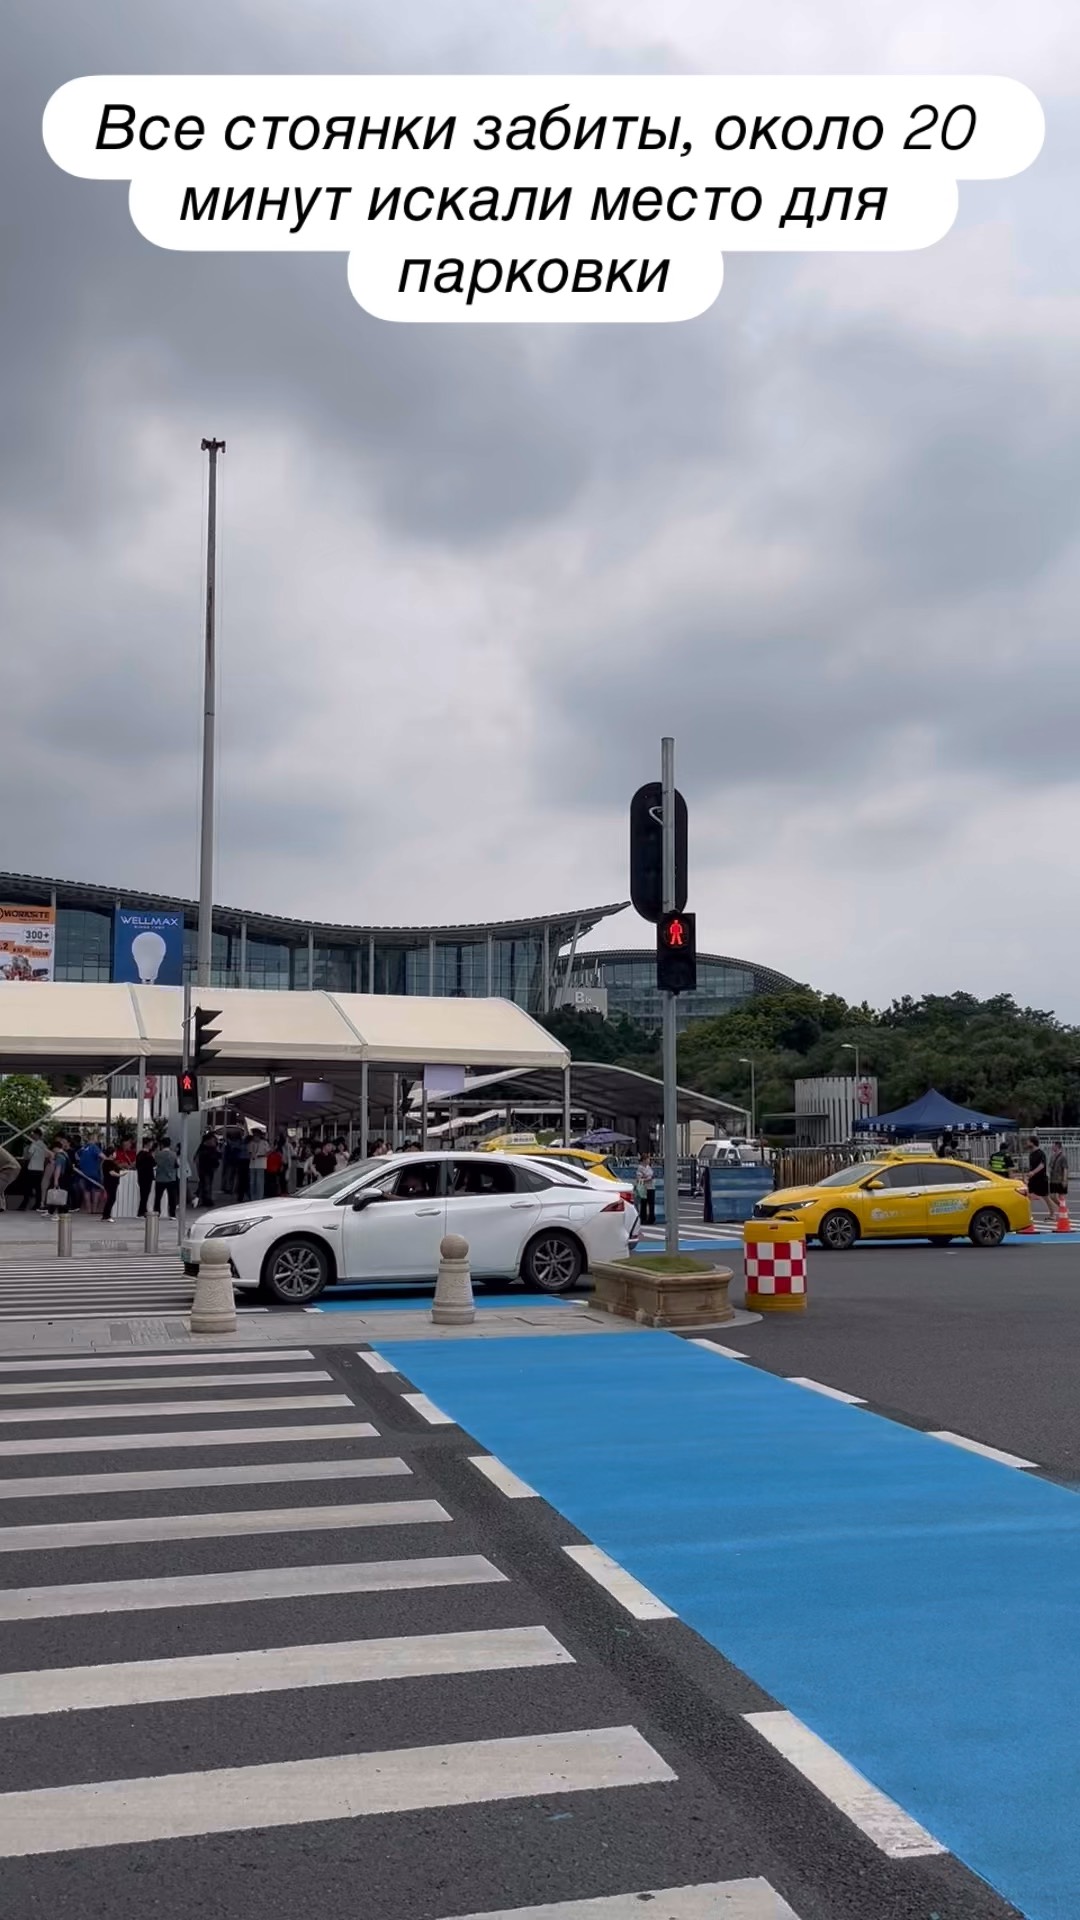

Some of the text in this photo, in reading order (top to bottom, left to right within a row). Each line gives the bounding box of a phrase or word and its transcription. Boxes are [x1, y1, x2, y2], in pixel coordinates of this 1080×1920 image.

[3, 910, 50, 919] WORKSITE
[120, 915, 179, 926] WELLMAX
[25, 930, 50, 940] 300+
